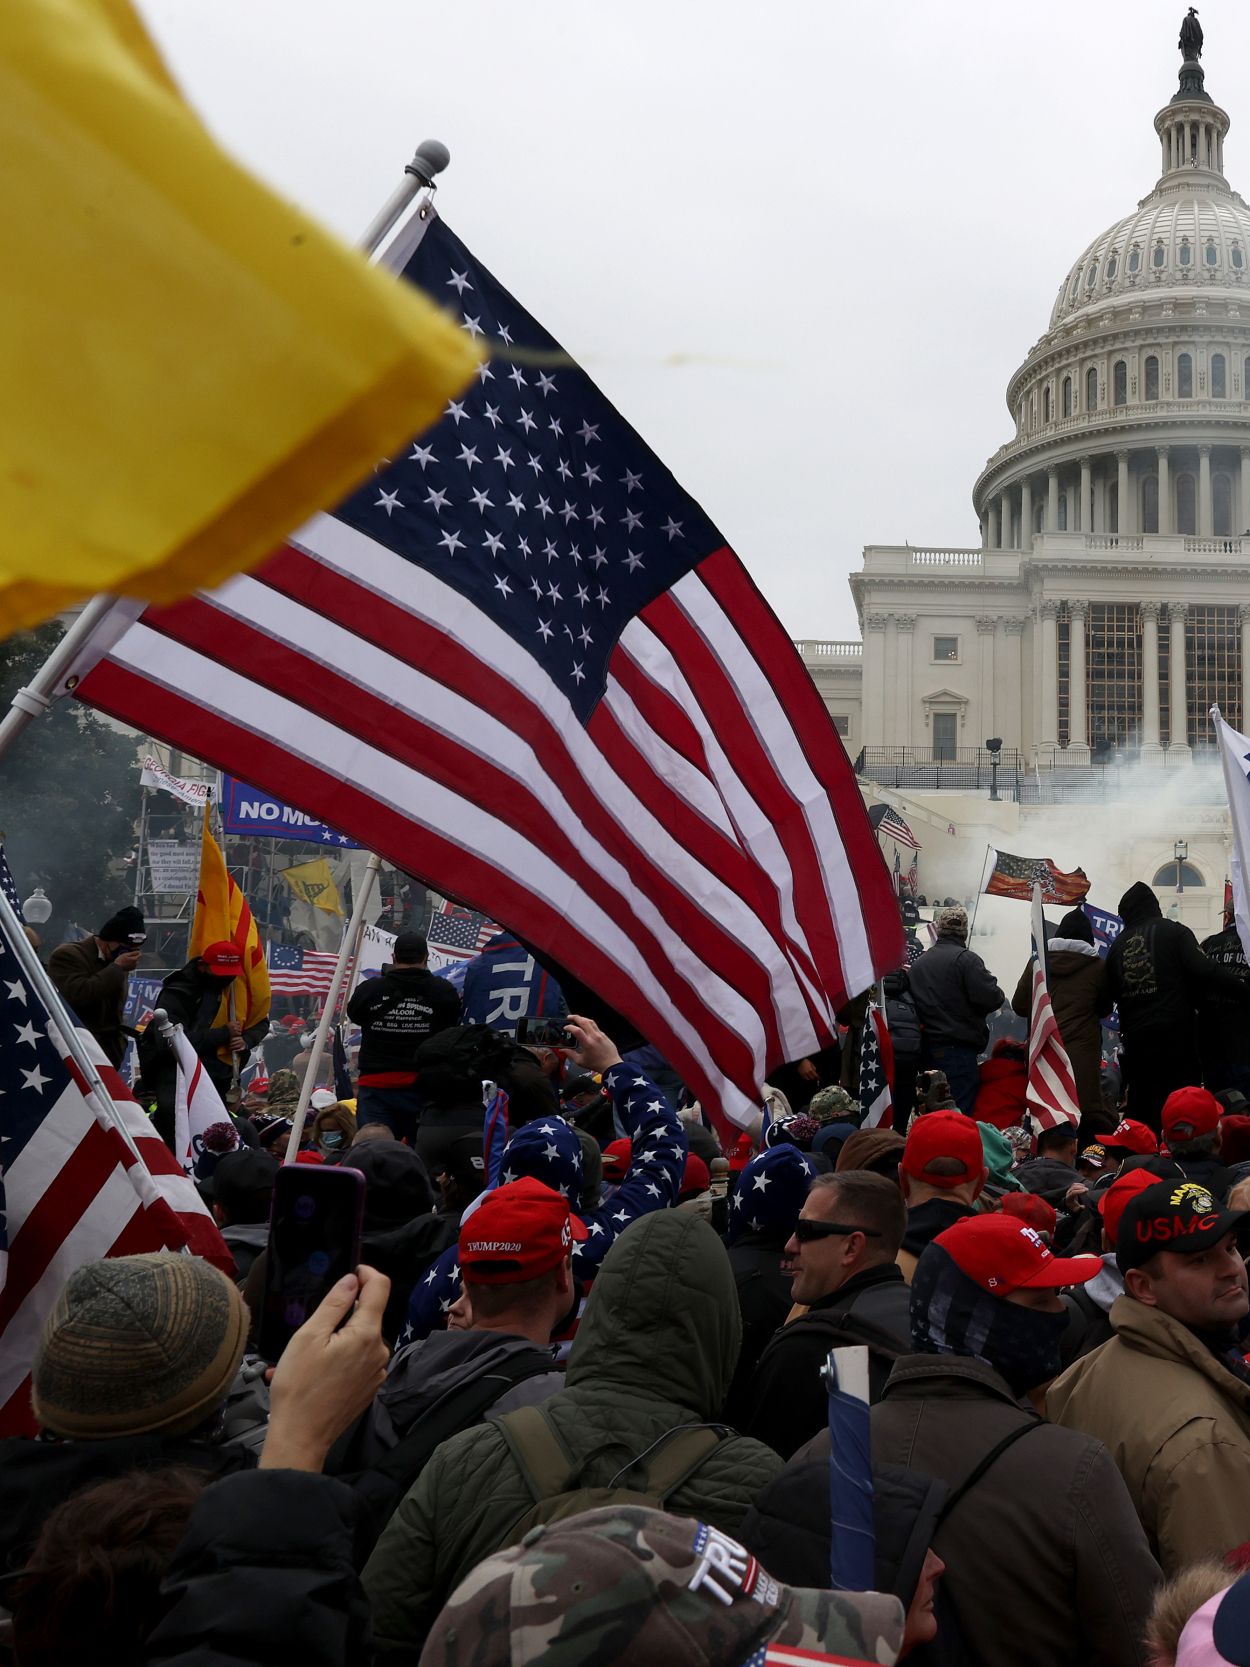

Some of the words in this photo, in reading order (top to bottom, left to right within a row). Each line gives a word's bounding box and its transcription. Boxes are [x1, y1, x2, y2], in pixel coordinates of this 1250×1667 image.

[239, 801, 280, 820] NO
[387, 1008, 415, 1016] ALOON
[1136, 1213, 1220, 1243] USMC
